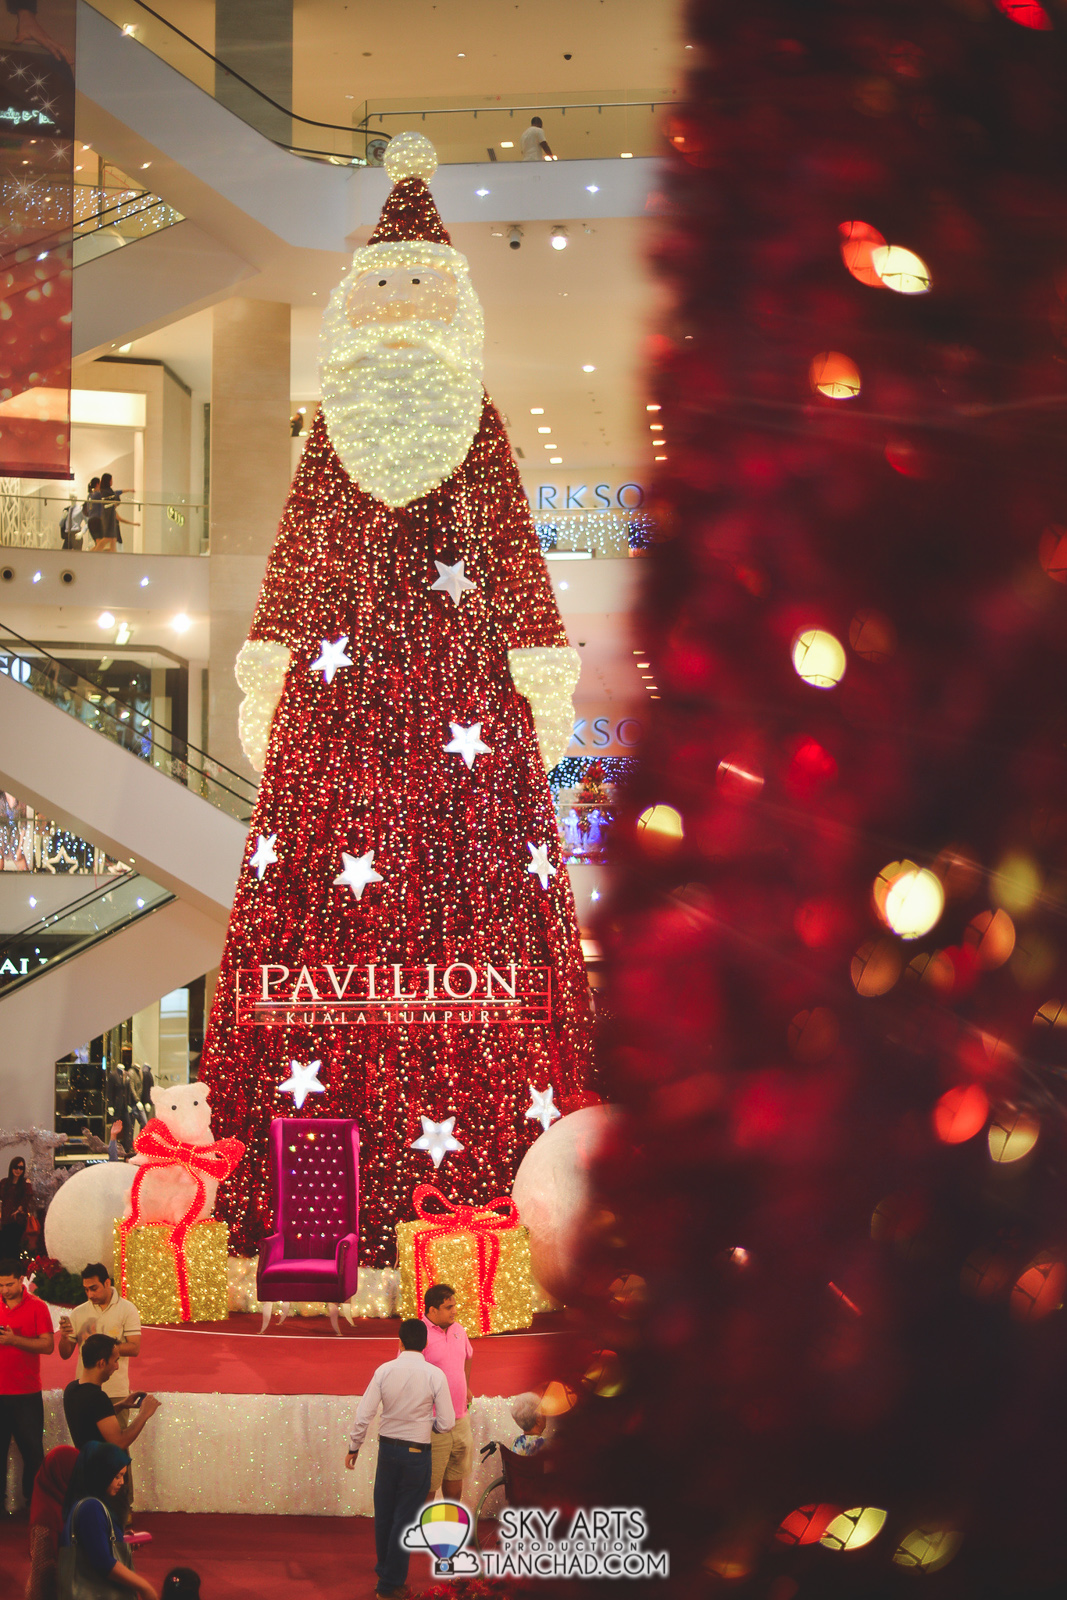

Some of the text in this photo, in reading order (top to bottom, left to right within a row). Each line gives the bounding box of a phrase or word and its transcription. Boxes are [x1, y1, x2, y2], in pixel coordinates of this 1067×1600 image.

[260, 963, 518, 999] PAVILION
[287, 1010, 490, 1024] KUALA LUMPUR
